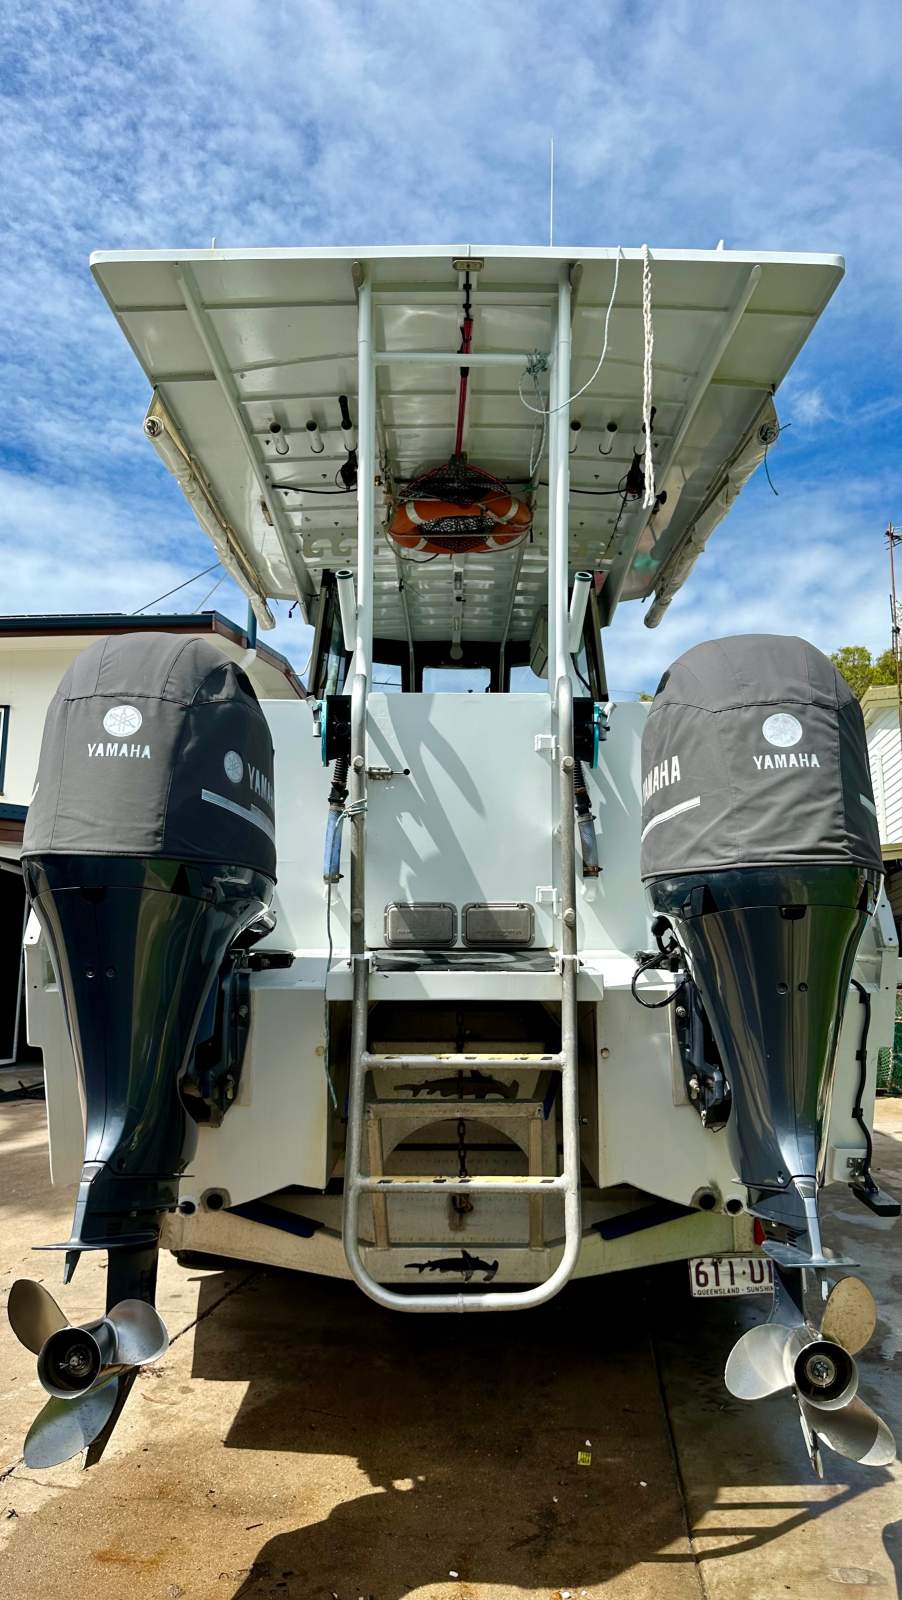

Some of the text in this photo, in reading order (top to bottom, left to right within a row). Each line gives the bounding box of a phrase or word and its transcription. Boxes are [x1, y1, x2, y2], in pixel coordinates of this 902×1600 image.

[87, 743, 151, 760] YAMAHA
[752, 753, 820, 770] YAMAHA
[641, 755, 681, 807] AMAHA
[697, 1287, 740, 1296] QUEENSLAND
